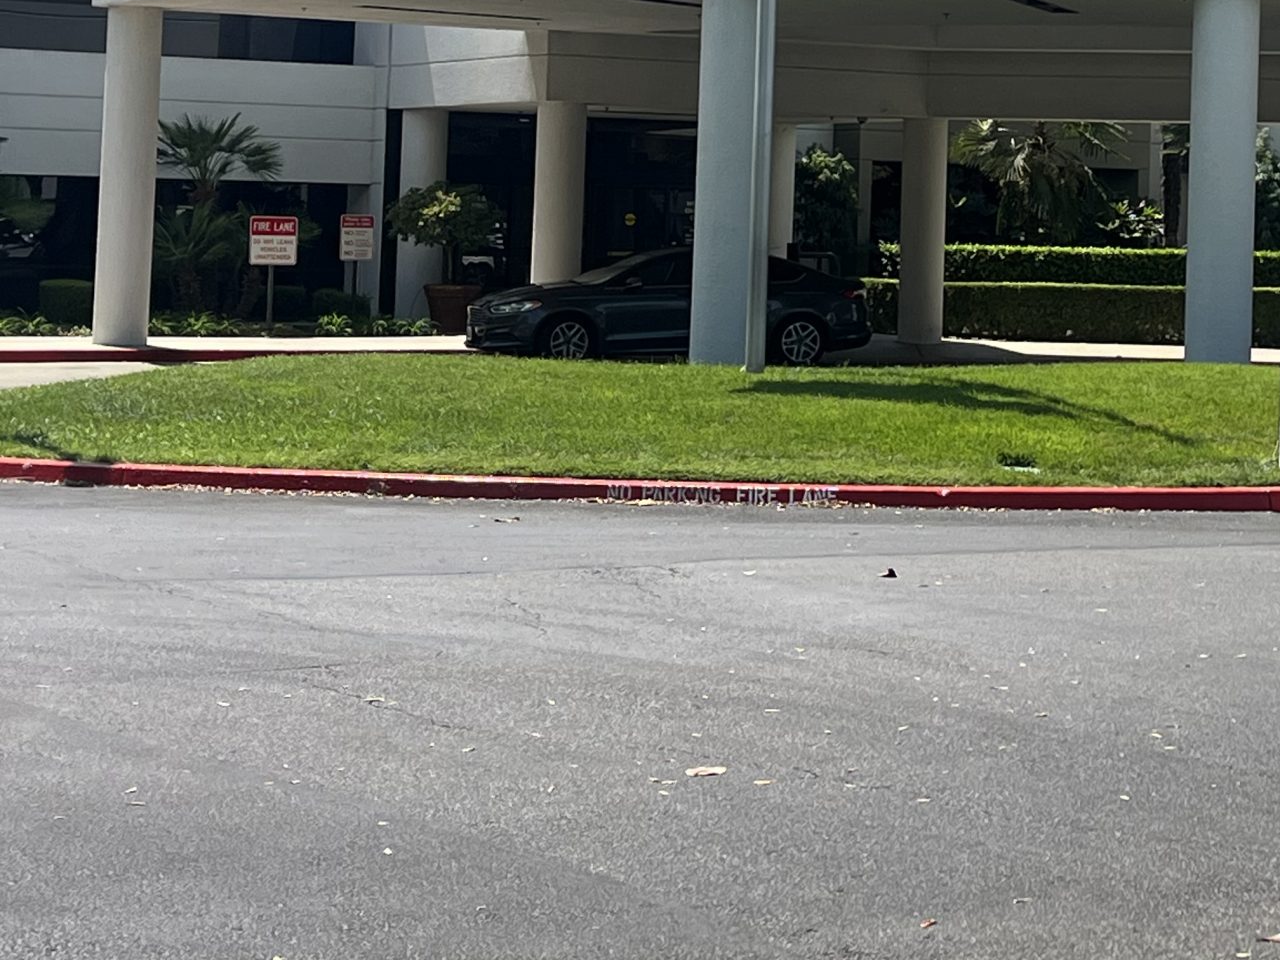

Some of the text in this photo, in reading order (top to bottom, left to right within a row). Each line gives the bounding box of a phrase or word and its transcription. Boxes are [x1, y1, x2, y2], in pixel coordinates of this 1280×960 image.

[253, 221, 295, 232] FIRE LANE
[606, 485, 632, 500] NO
[736, 488, 778, 505] FIRE
